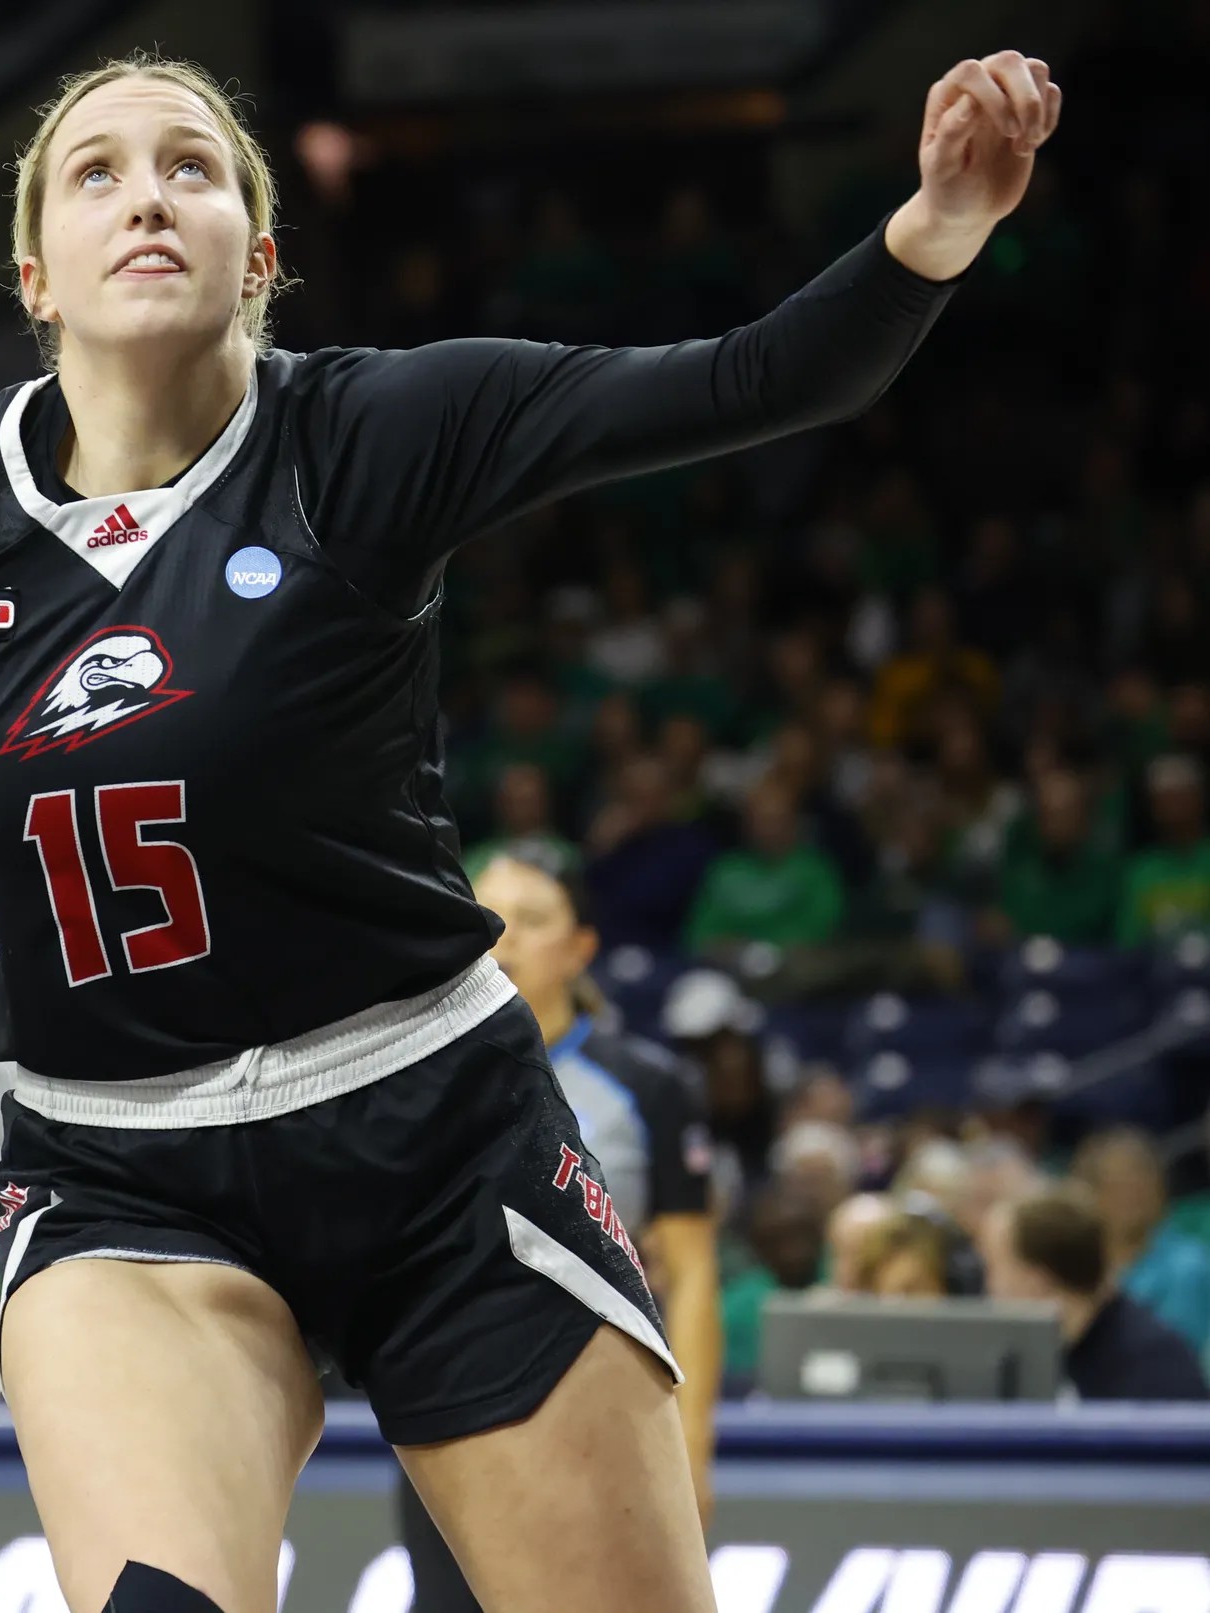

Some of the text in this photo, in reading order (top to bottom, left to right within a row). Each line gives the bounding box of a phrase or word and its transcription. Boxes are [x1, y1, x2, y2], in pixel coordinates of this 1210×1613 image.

[87, 529, 149, 549] adidas
[232, 571, 277, 587] NCAA
[23, 780, 211, 988] 15
